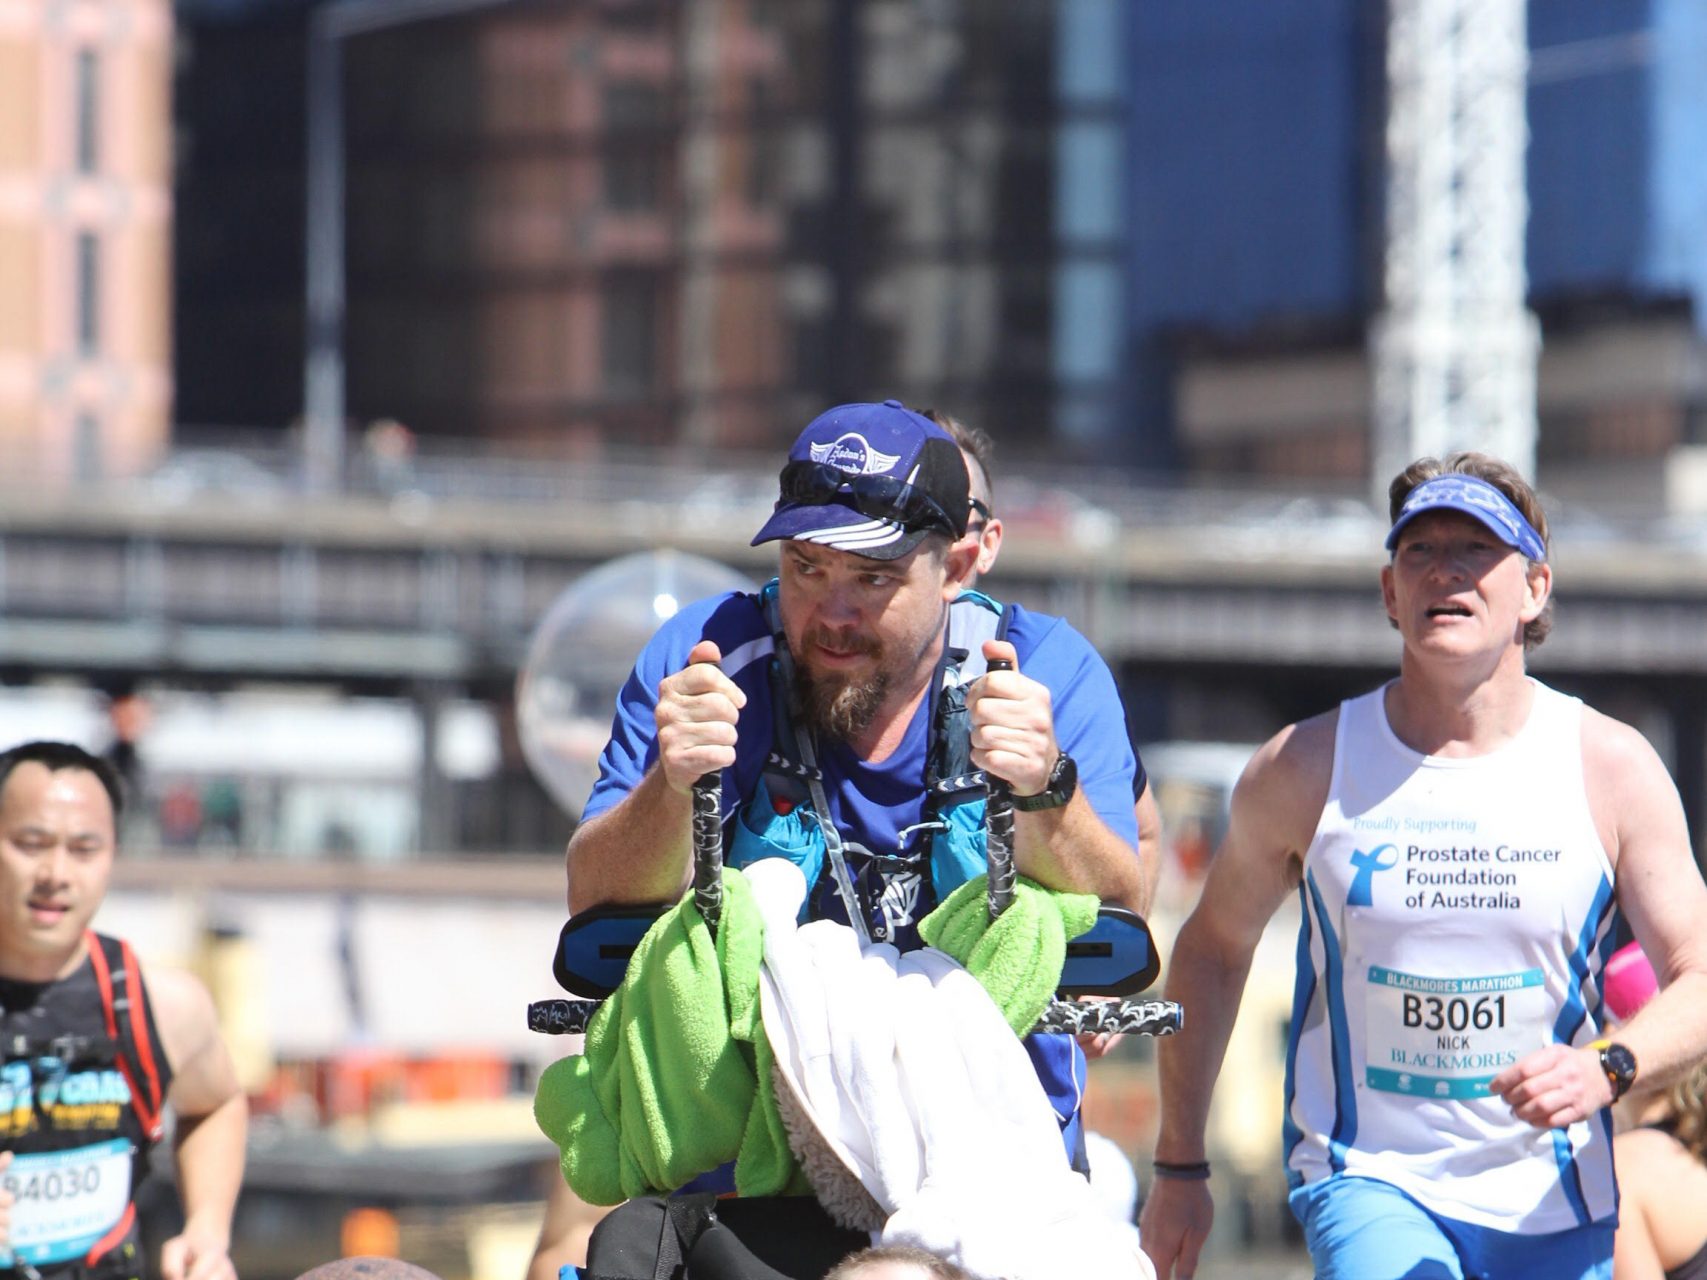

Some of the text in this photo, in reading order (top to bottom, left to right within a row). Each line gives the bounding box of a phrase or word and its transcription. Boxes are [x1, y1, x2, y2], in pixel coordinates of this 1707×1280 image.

[1353, 817, 1477, 833] Proudly Supporting
[1406, 845, 1562, 863] Prostate Cancer
[1406, 869, 1517, 886] Foundation
[1405, 891, 1521, 910] of Australia
[1386, 971, 1524, 993] BLACKMORES MARATHON
[1402, 994, 1506, 1031] B3061
[1436, 1035, 1471, 1050] NICK
[1390, 1049, 1516, 1070] BLACKMORES
